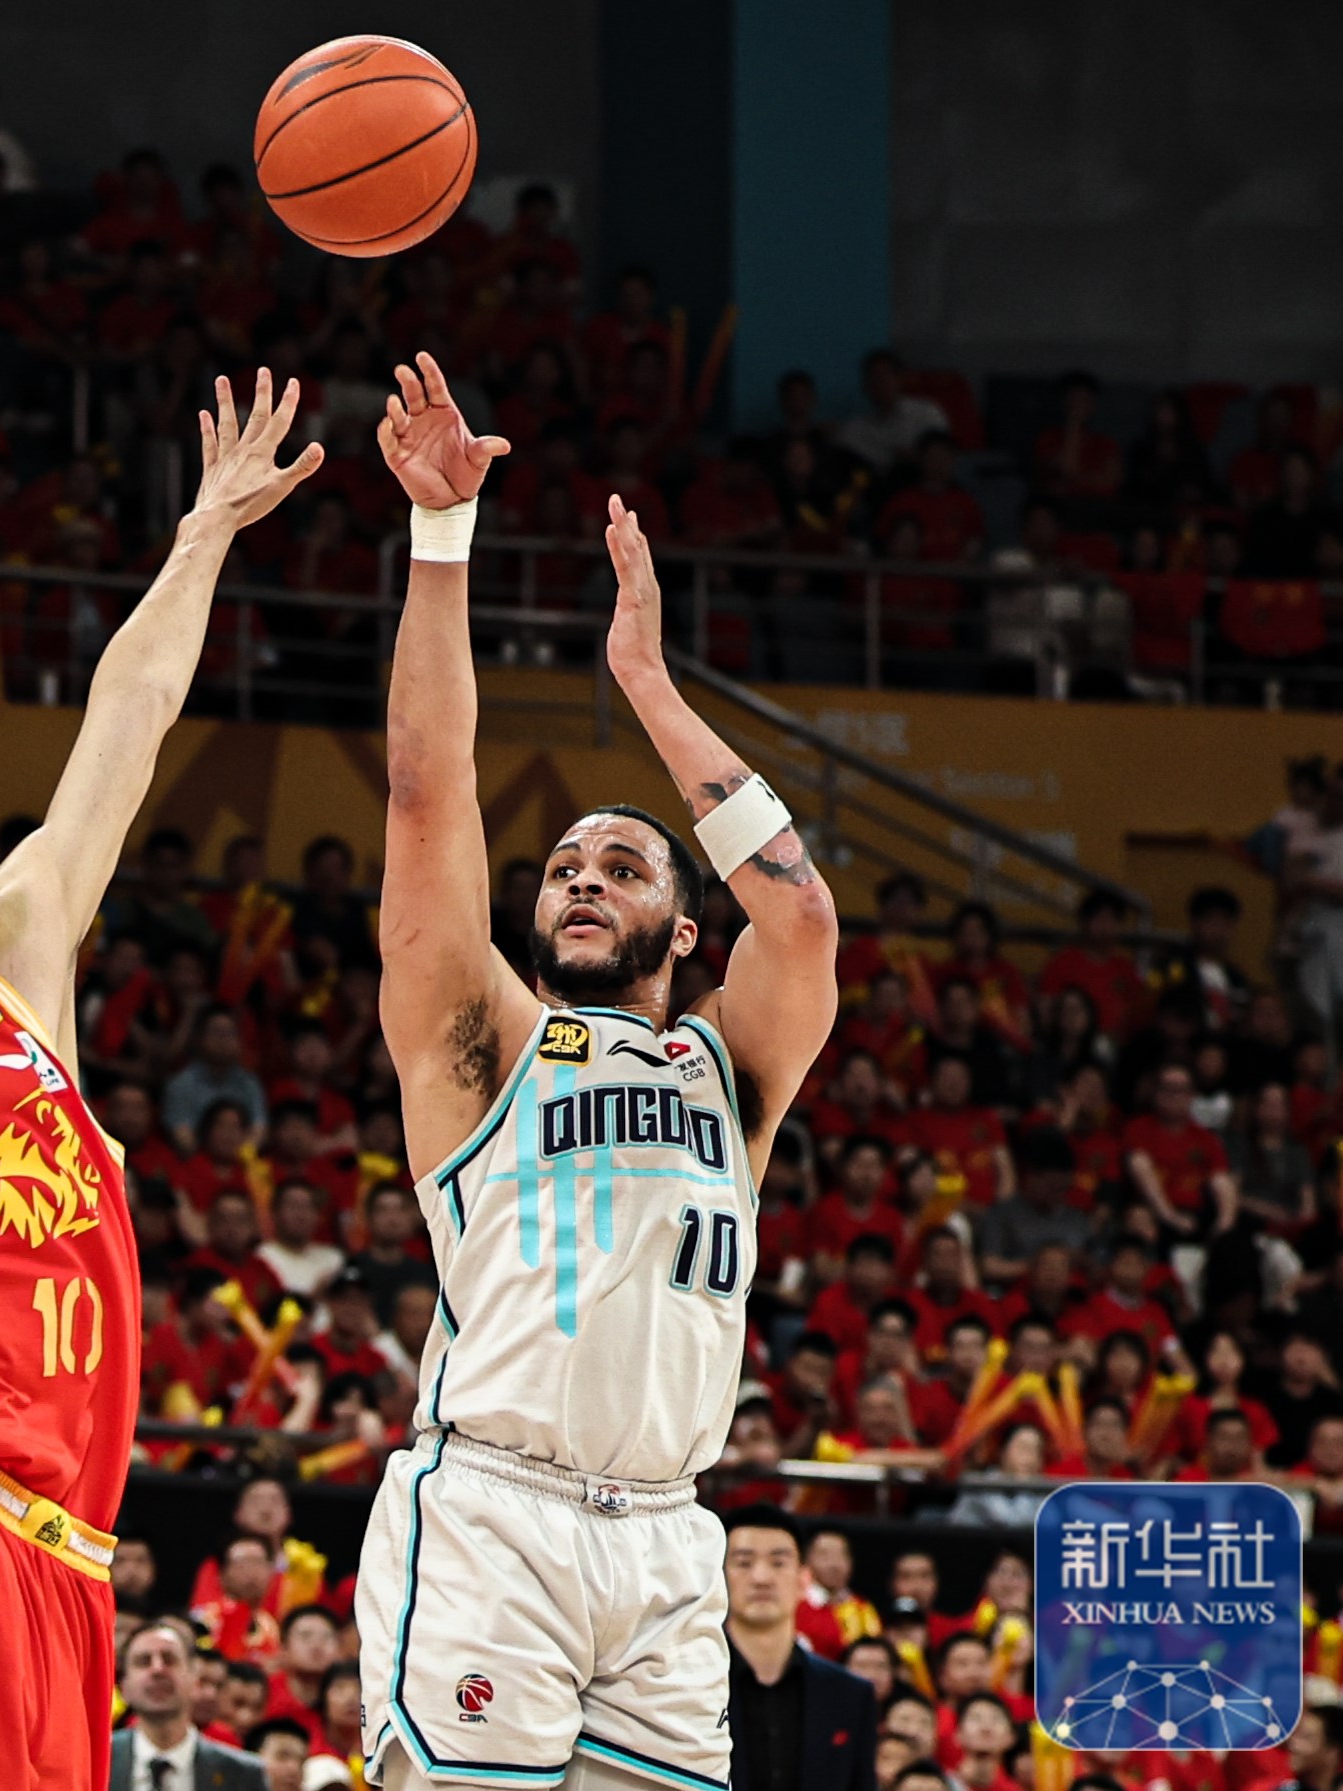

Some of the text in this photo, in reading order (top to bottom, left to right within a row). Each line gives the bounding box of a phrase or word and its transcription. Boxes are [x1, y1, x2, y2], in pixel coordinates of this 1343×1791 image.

[551, 1043, 582, 1055] CBA
[674, 1054, 706, 1071] 发银行
[682, 1067, 706, 1082] CGB
[671, 1205, 739, 1297] 10
[32, 1276, 104, 1378] 10
[458, 1713, 489, 1723] CBA
